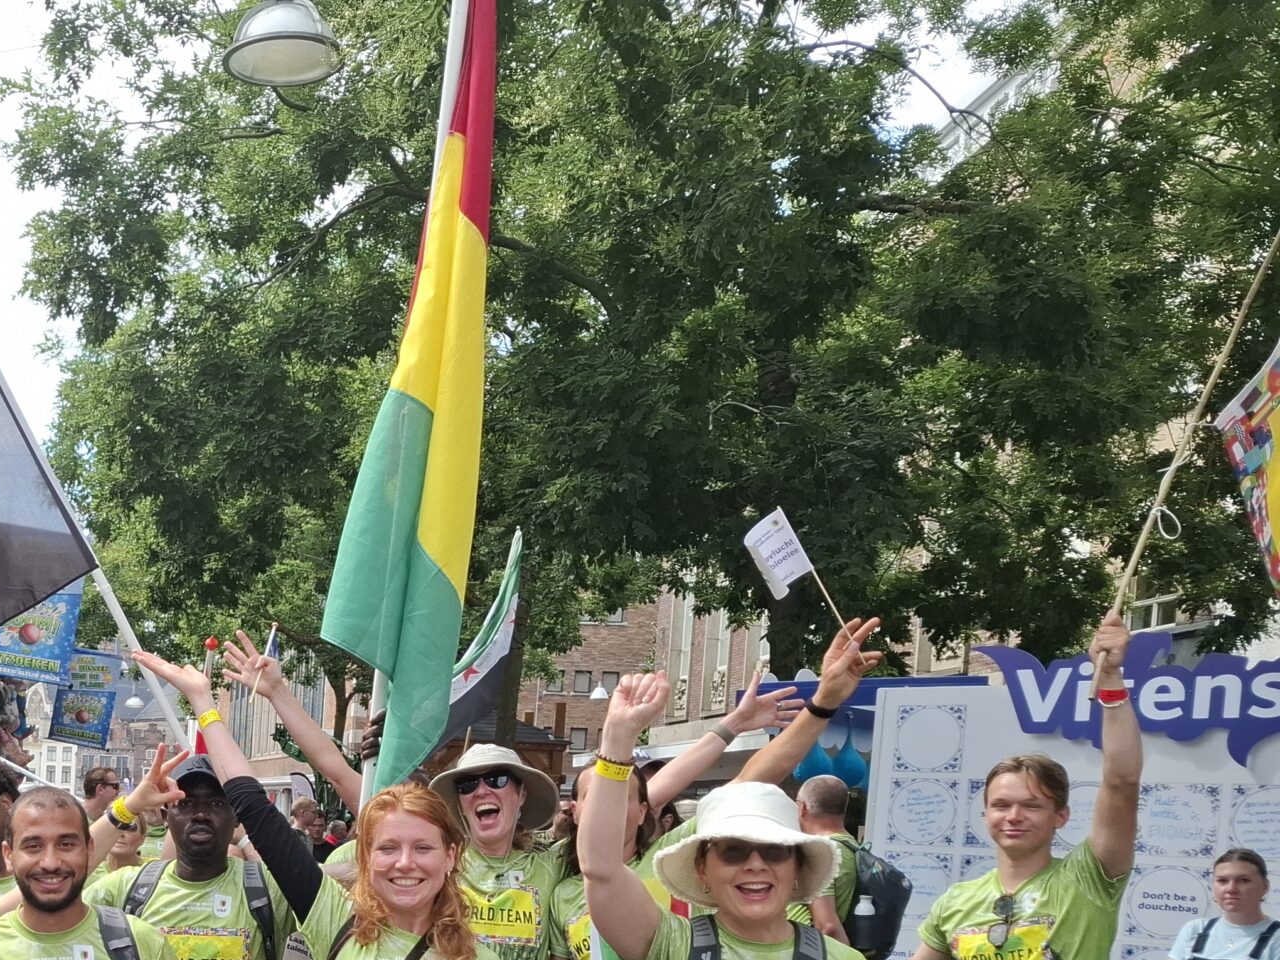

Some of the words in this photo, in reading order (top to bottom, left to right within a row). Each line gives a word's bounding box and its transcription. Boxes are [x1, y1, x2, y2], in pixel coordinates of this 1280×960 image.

[765, 538, 795, 562] vlucht
[1017, 661, 1280, 722] Viens
[1142, 891, 1171, 900] Don't
[1173, 892, 1188, 901] be
[500, 907, 533, 925] TEAM
[1138, 903, 1199, 915] douchebag
